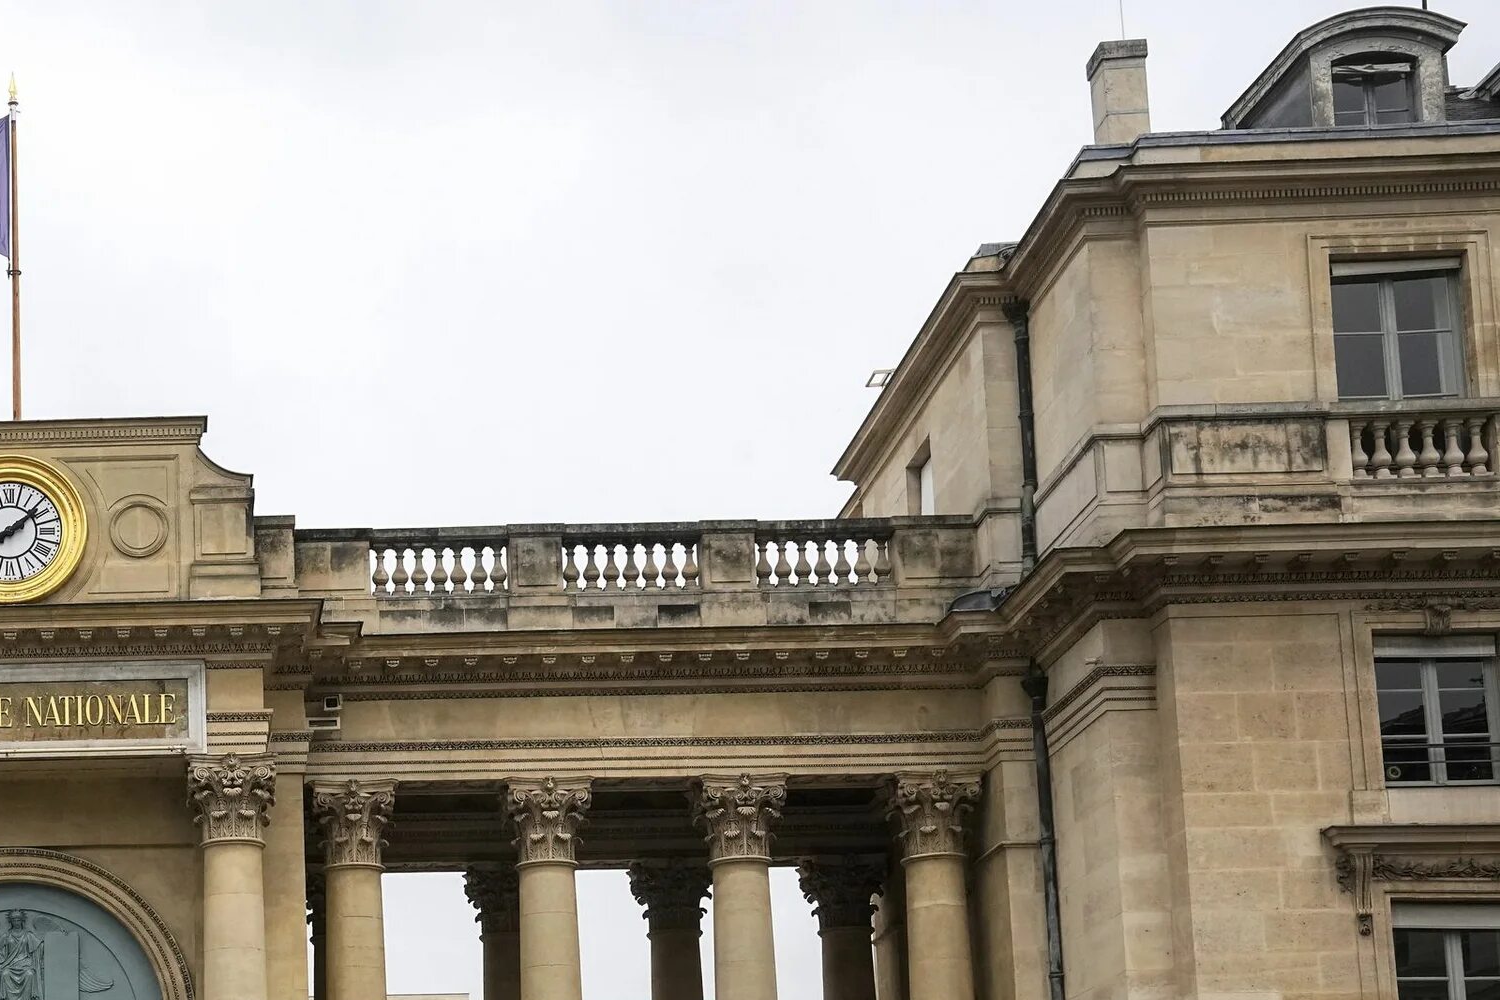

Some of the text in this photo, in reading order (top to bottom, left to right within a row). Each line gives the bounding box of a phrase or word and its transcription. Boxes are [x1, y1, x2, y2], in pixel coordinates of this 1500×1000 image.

[3, 488, 15, 504] XII
[39, 527, 56, 536] III
[5, 560, 15, 576] VI
[25, 692, 177, 729] NATIONALE
